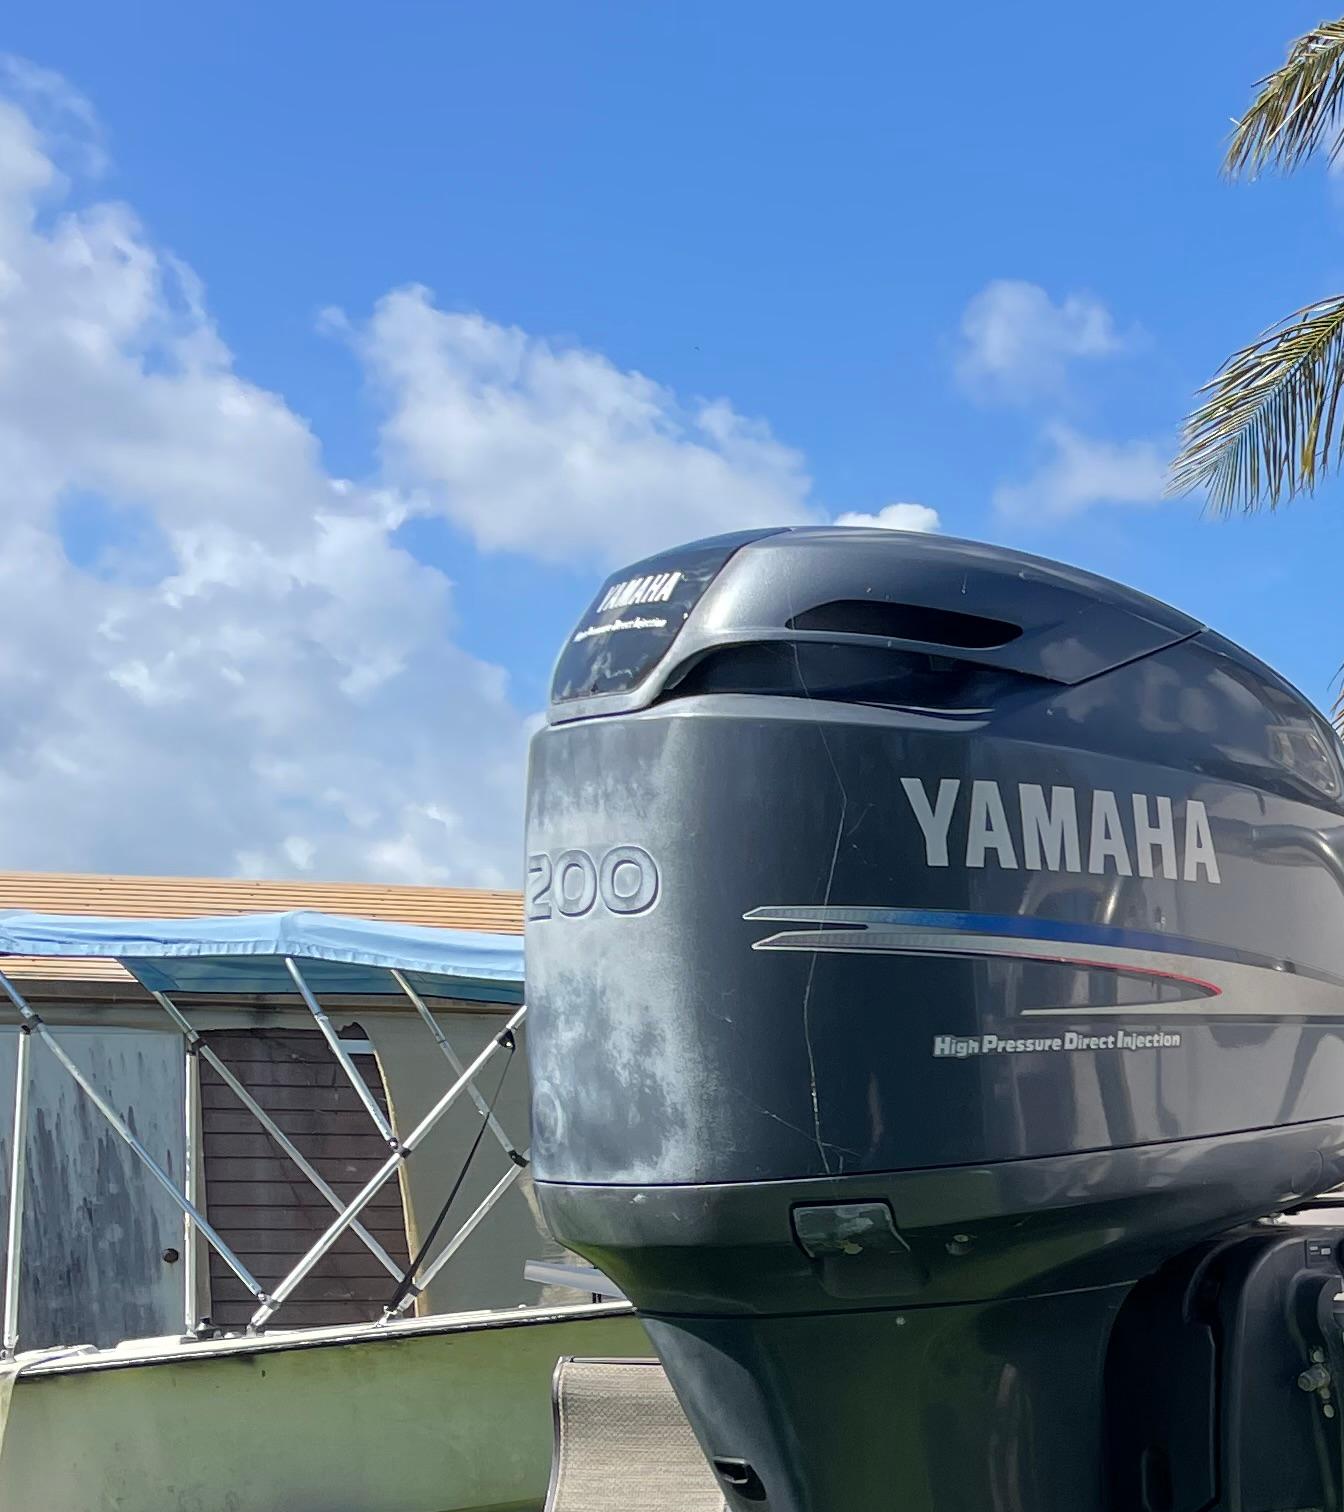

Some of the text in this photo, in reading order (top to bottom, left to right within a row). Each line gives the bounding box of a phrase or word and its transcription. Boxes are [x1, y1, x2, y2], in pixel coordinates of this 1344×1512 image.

[900, 777, 1221, 884] YAMAHA
[526, 844, 661, 923] 200
[934, 1031, 1181, 1057] High Pressure Direct Injection
